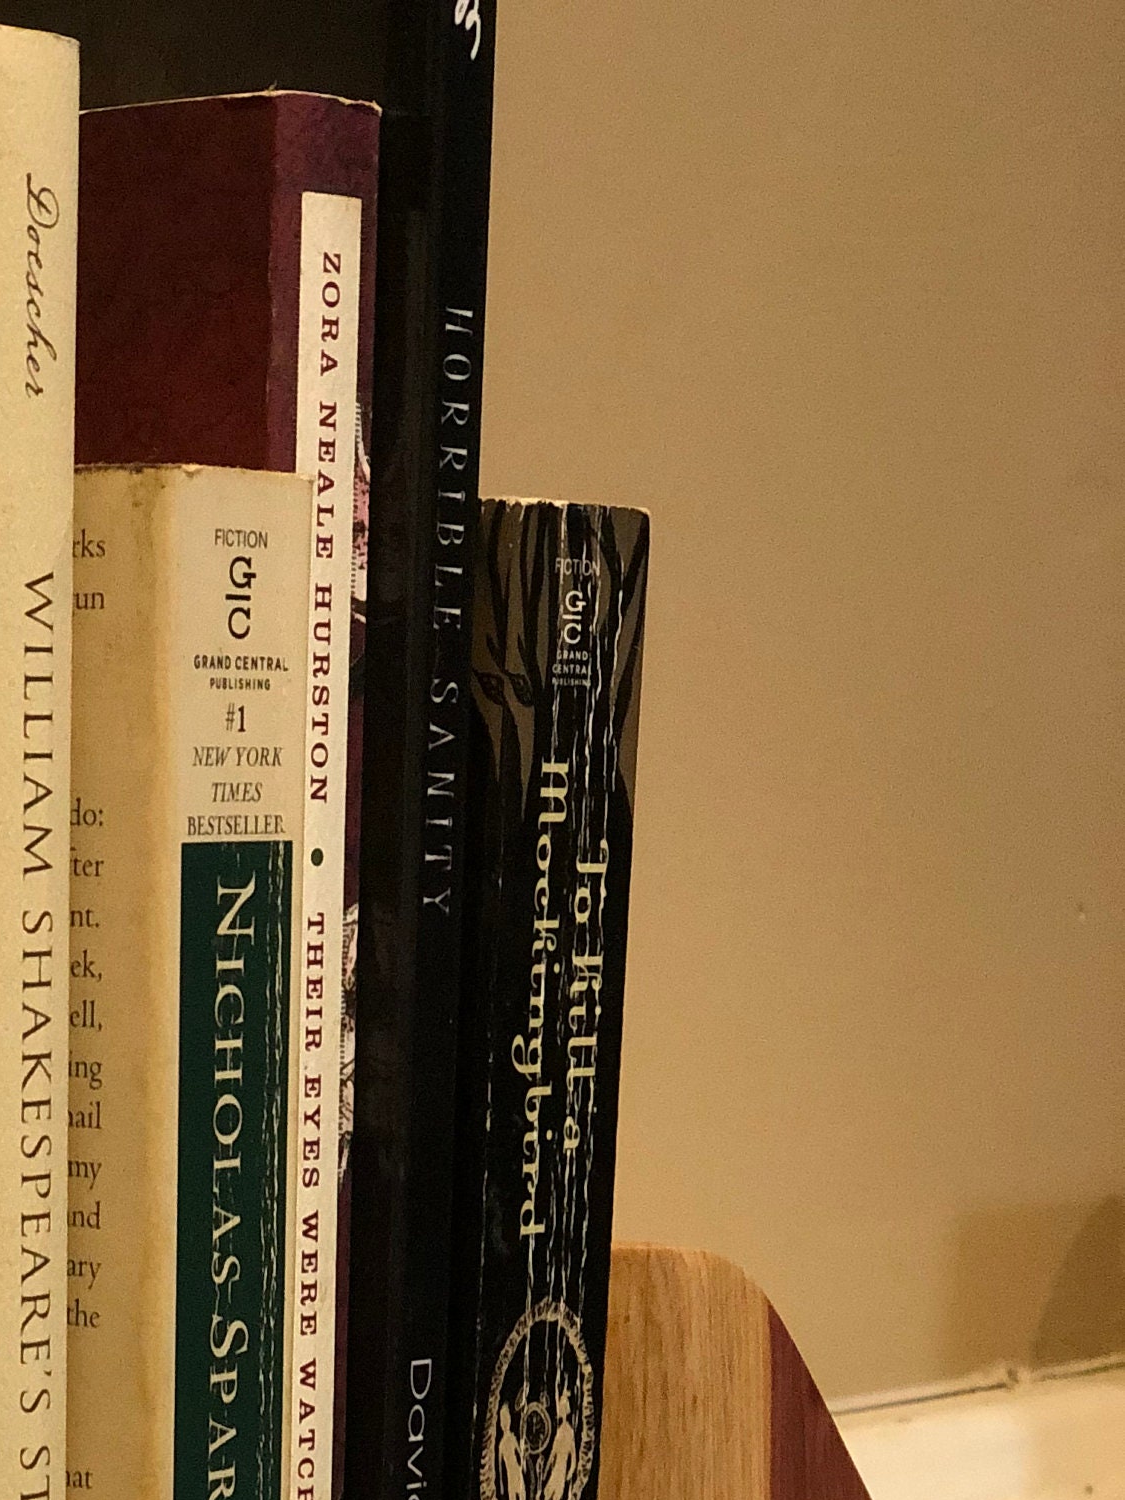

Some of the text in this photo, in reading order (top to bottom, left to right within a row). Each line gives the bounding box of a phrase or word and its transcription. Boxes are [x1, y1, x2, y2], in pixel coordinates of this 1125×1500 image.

[26, 172, 59, 399] Doescher
[320, 252, 341, 377] ZORA
[316, 401, 337, 559] NEALE
[72, 528, 106, 558] rks
[215, 528, 268, 549] FICTION
[555, 557, 600, 577] FICTION
[73, 592, 104, 611] un
[422, 306, 473, 916] HORRIBLE SANITY
[193, 654, 289, 672] GRAND CENTRAL
[557, 651, 588, 661] GRAND
[209, 677, 271, 691] PUBLISHING
[310, 583, 332, 803] HURSTON
[23, 572, 54, 880] WILLIAM
[225, 703, 246, 733] #1
[192, 746, 283, 767] NEW YORK
[211, 782, 262, 803] TIMES
[187, 815, 286, 837] BESTSELLER
[70, 847, 104, 877] ter
[305, 912, 325, 1052] THEIR
[211, 870, 256, 1286] NICHOLAS
[302, 1074, 322, 1189] EYES
[563, 1113, 581, 1155] a
[20, 910, 52, 1413] SHAKESPEARE'S
[299, 1210, 319, 1337] WERE
